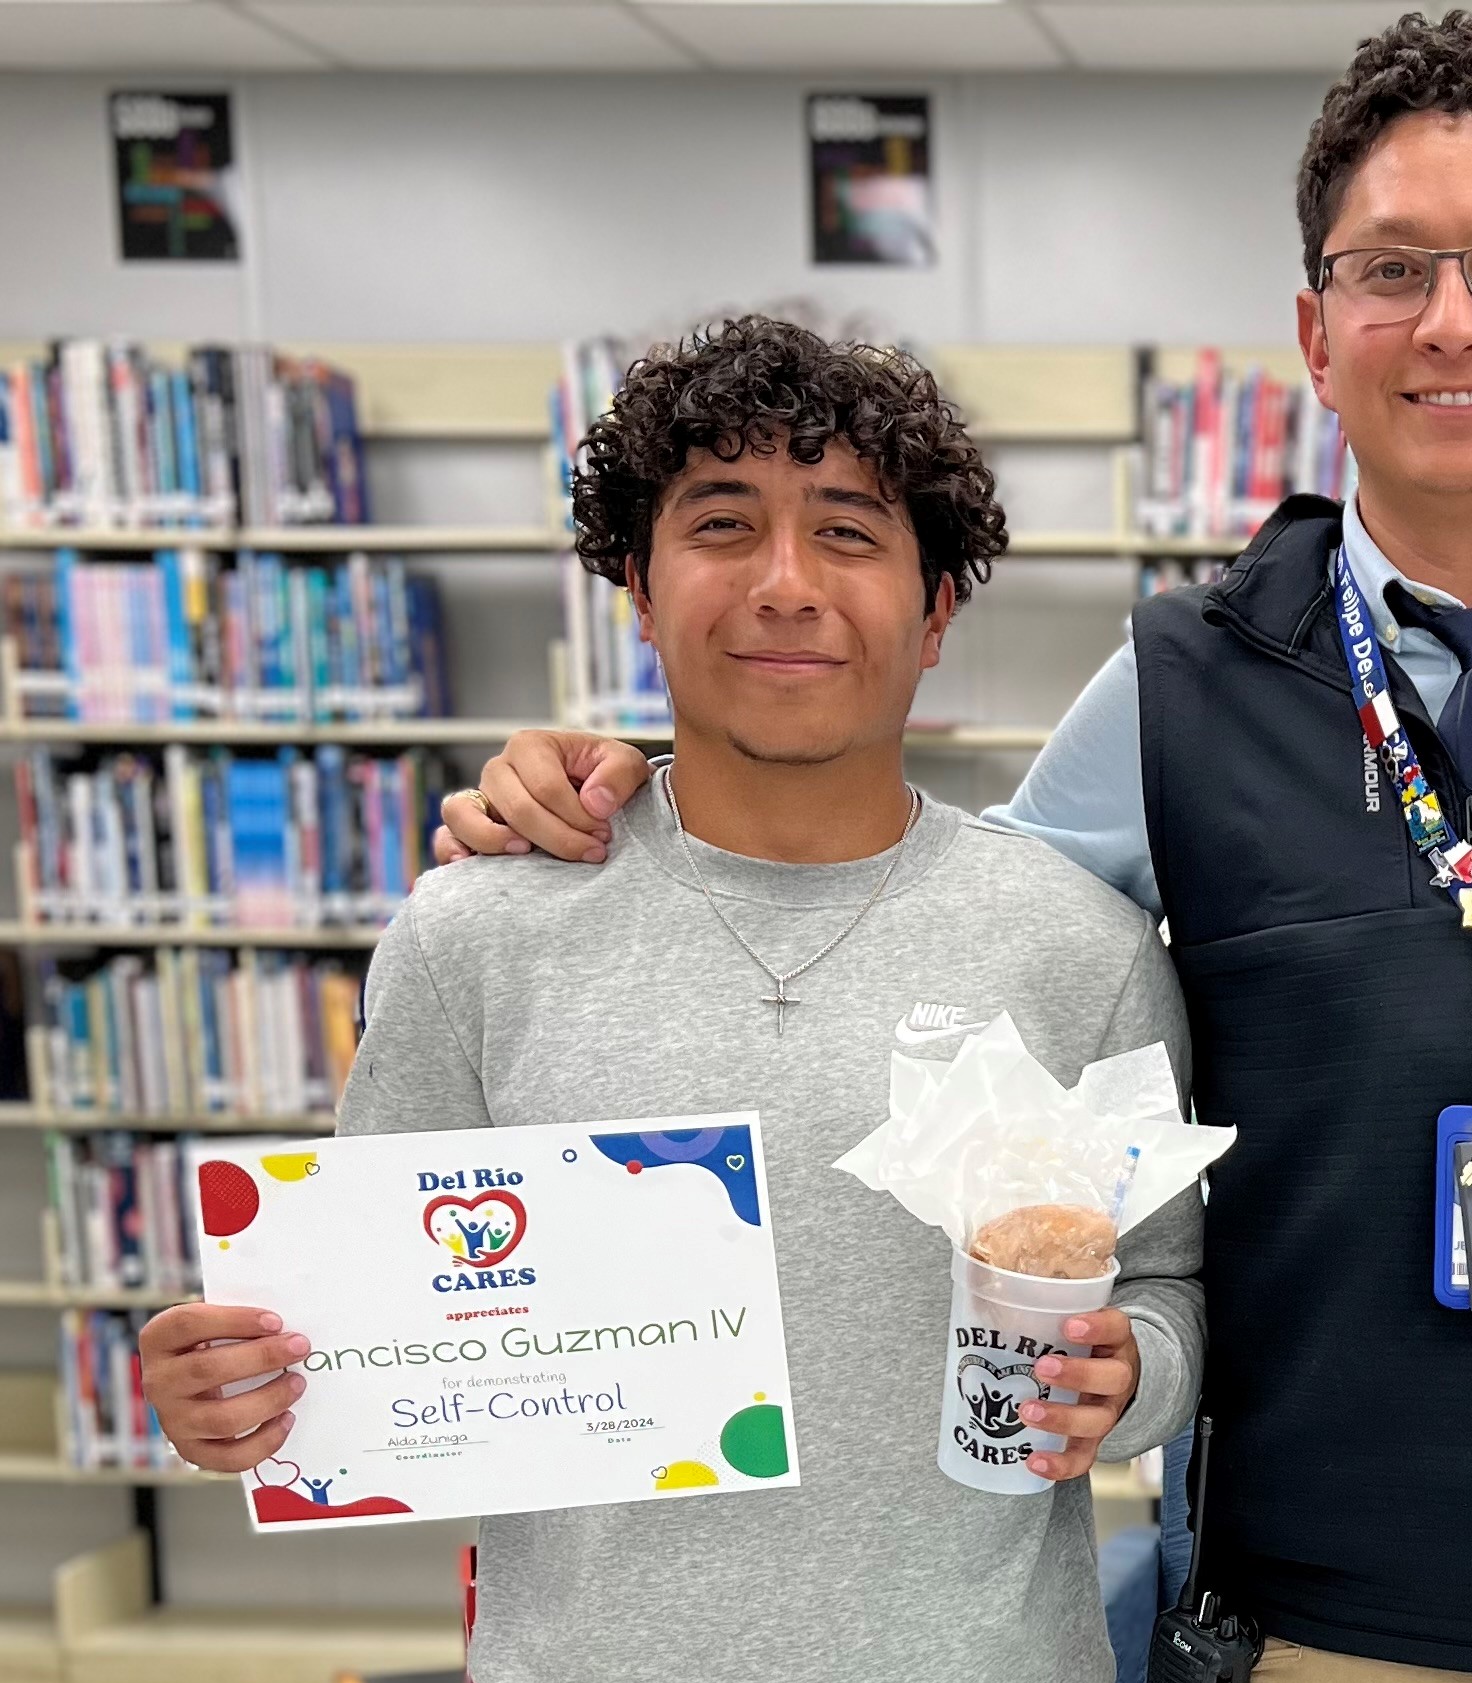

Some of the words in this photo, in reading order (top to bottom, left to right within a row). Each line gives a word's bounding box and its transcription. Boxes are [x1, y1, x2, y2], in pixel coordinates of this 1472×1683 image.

[1340, 568, 1364, 637] Felipe
[1363, 734, 1380, 813] RMOUR
[909, 1001, 967, 1029] NIKE
[416, 1170, 467, 1191] Del
[472, 1168, 524, 1188] Rio
[432, 1267, 537, 1292] CARES
[445, 1305, 529, 1322] appreciates
[284, 1338, 487, 1373] ancisco
[500, 1319, 698, 1358] Guzman
[711, 1306, 747, 1340] IV
[956, 1327, 1007, 1351] DEL
[442, 1376, 461, 1391] for
[467, 1371, 567, 1389] demonstrating
[391, 1382, 628, 1428] Self-Control
[586, 1418, 654, 1434] 3/28/2024
[420, 1432, 468, 1447] Zuniga
[954, 1425, 1034, 1466] CARES
